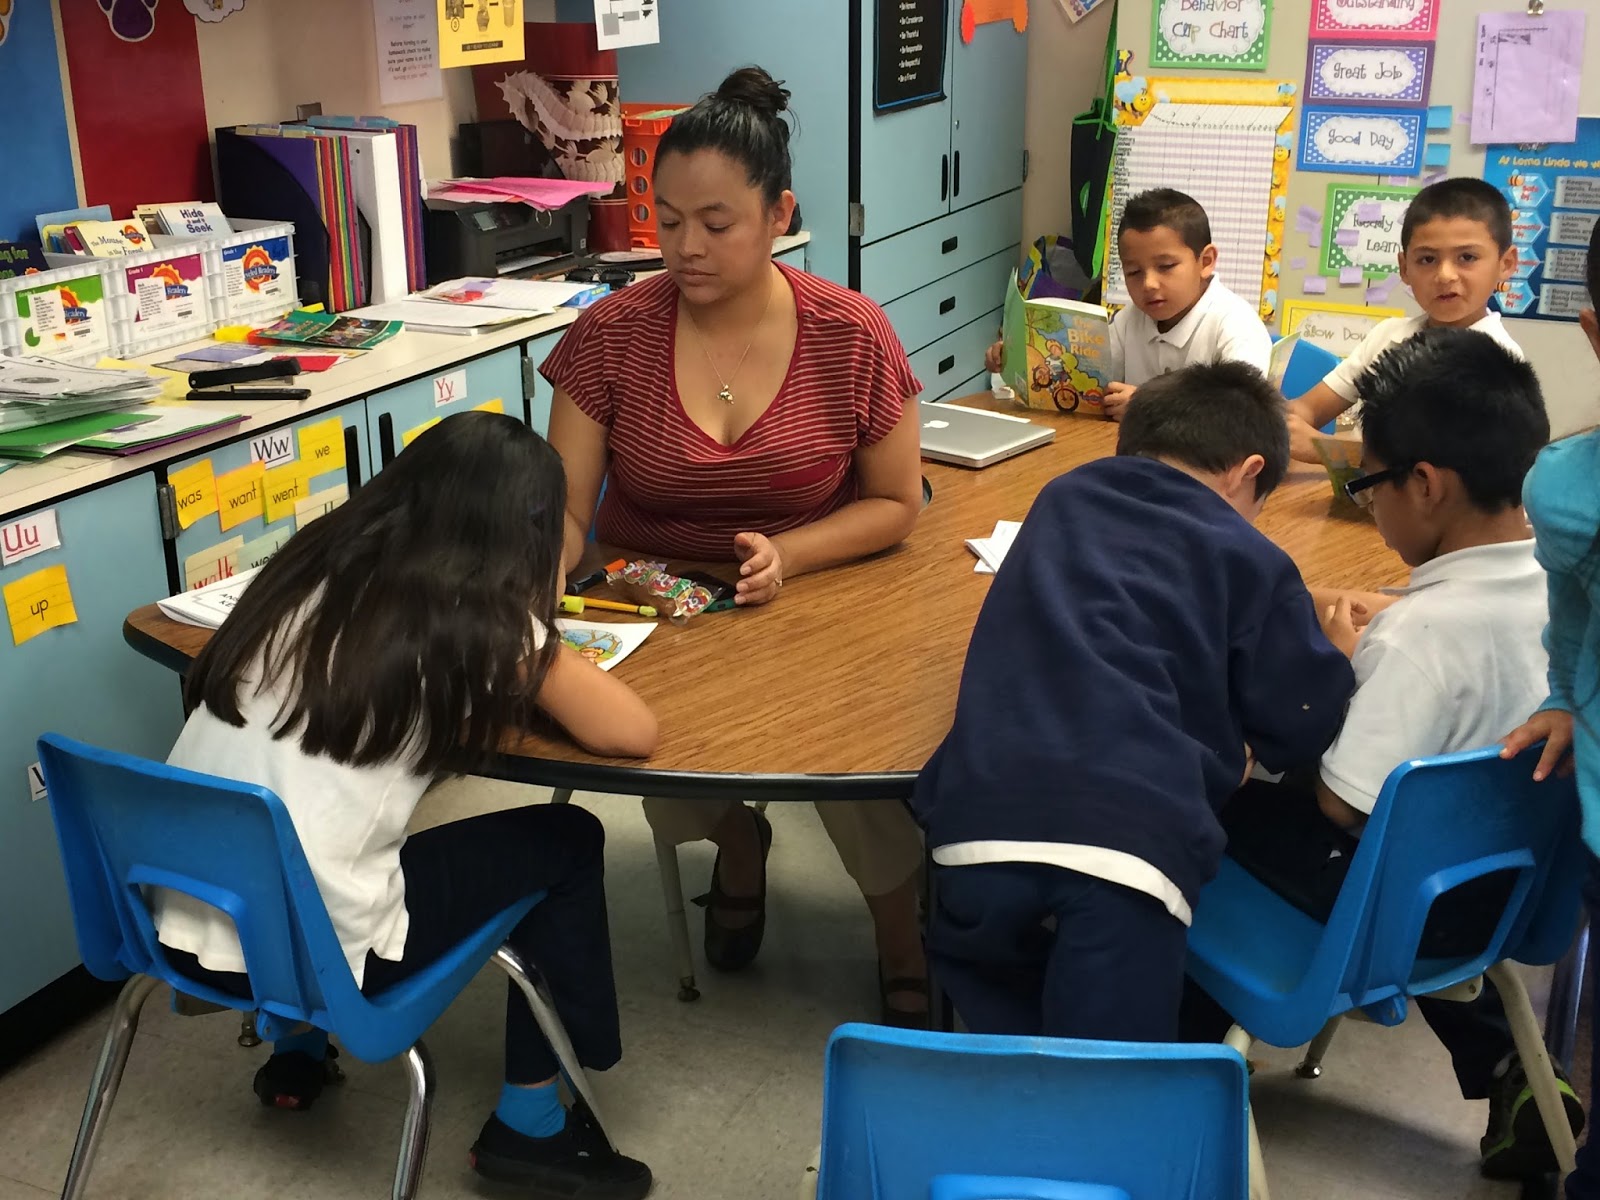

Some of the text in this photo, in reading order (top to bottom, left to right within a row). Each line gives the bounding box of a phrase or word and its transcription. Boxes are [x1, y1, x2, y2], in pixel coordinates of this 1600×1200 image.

[1172, 21, 1249, 44] Clip Chart
[1375, 62, 1402, 79] Job
[1370, 131, 1394, 150] Day
[1543, 157, 1570, 168] Linda
[180, 208, 204, 219] Hide
[186, 223, 213, 233] Seek
[1367, 239, 1401, 253] Learn
[1068, 328, 1105, 345] Bike
[1303, 324, 1366, 342] Slow Dow
[1071, 344, 1100, 358] Ride
[436, 378, 454, 402] Yy
[253, 437, 289, 460] Ww
[315, 445, 330, 459] we
[178, 490, 202, 510] was
[229, 481, 257, 509] want
[272, 478, 299, 504] went
[2, 523, 40, 553] Uu
[30, 599, 49, 621] up
